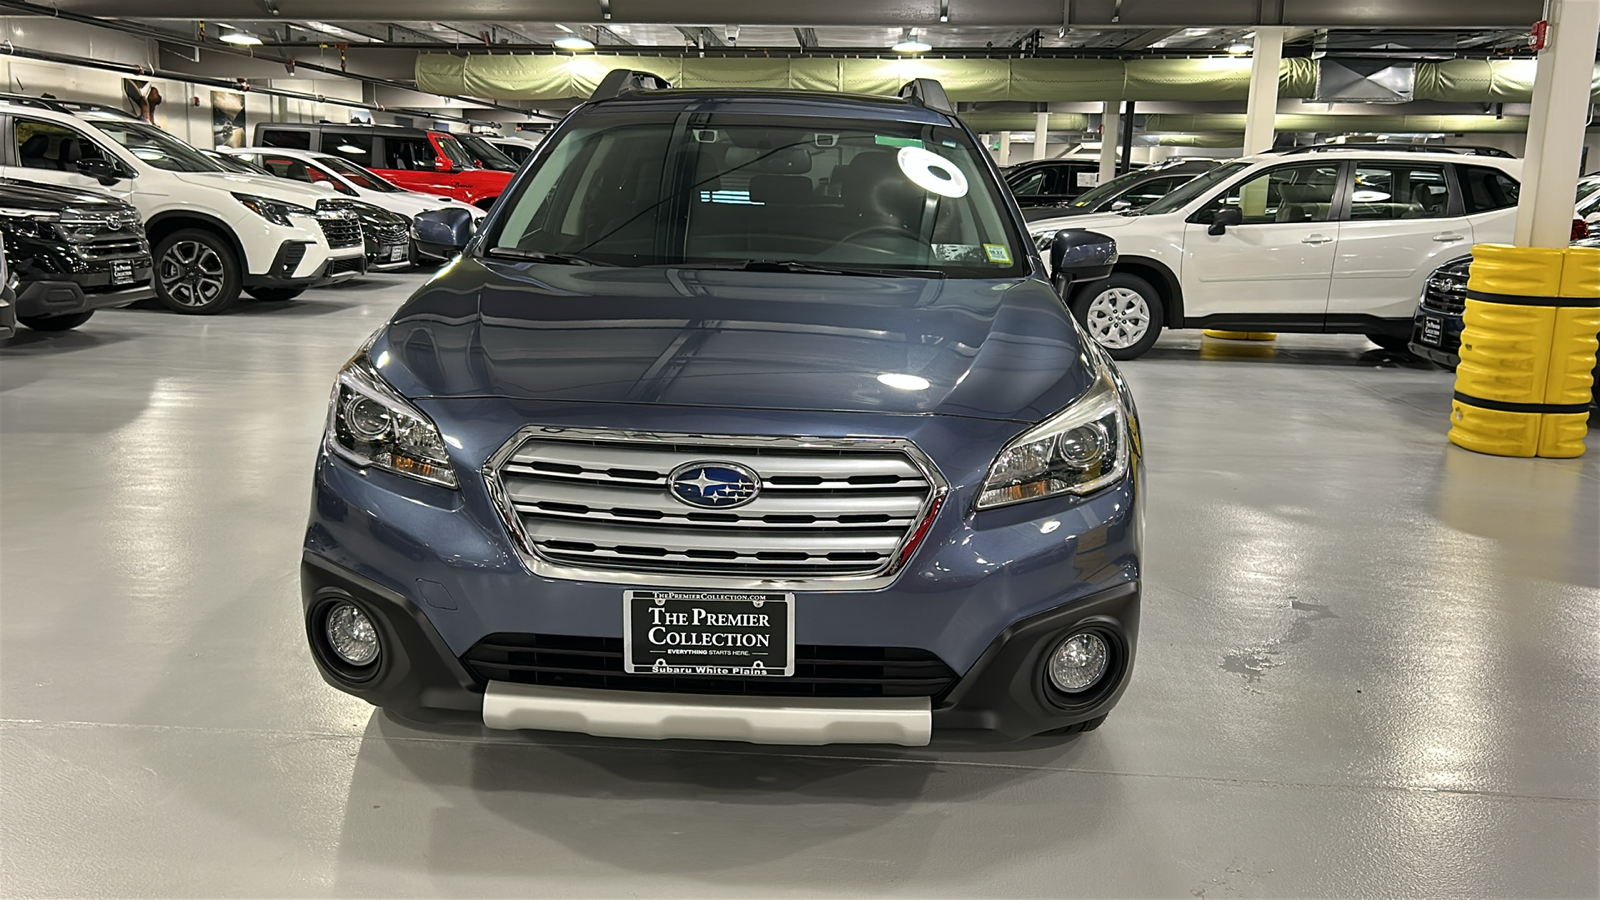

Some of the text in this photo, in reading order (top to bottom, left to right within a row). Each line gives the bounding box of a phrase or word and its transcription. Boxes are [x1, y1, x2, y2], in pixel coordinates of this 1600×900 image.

[648, 607, 770, 627] THE PREMIER
[648, 626, 770, 647] COLLECTION
[652, 666, 768, 676] Subaru White Plains
